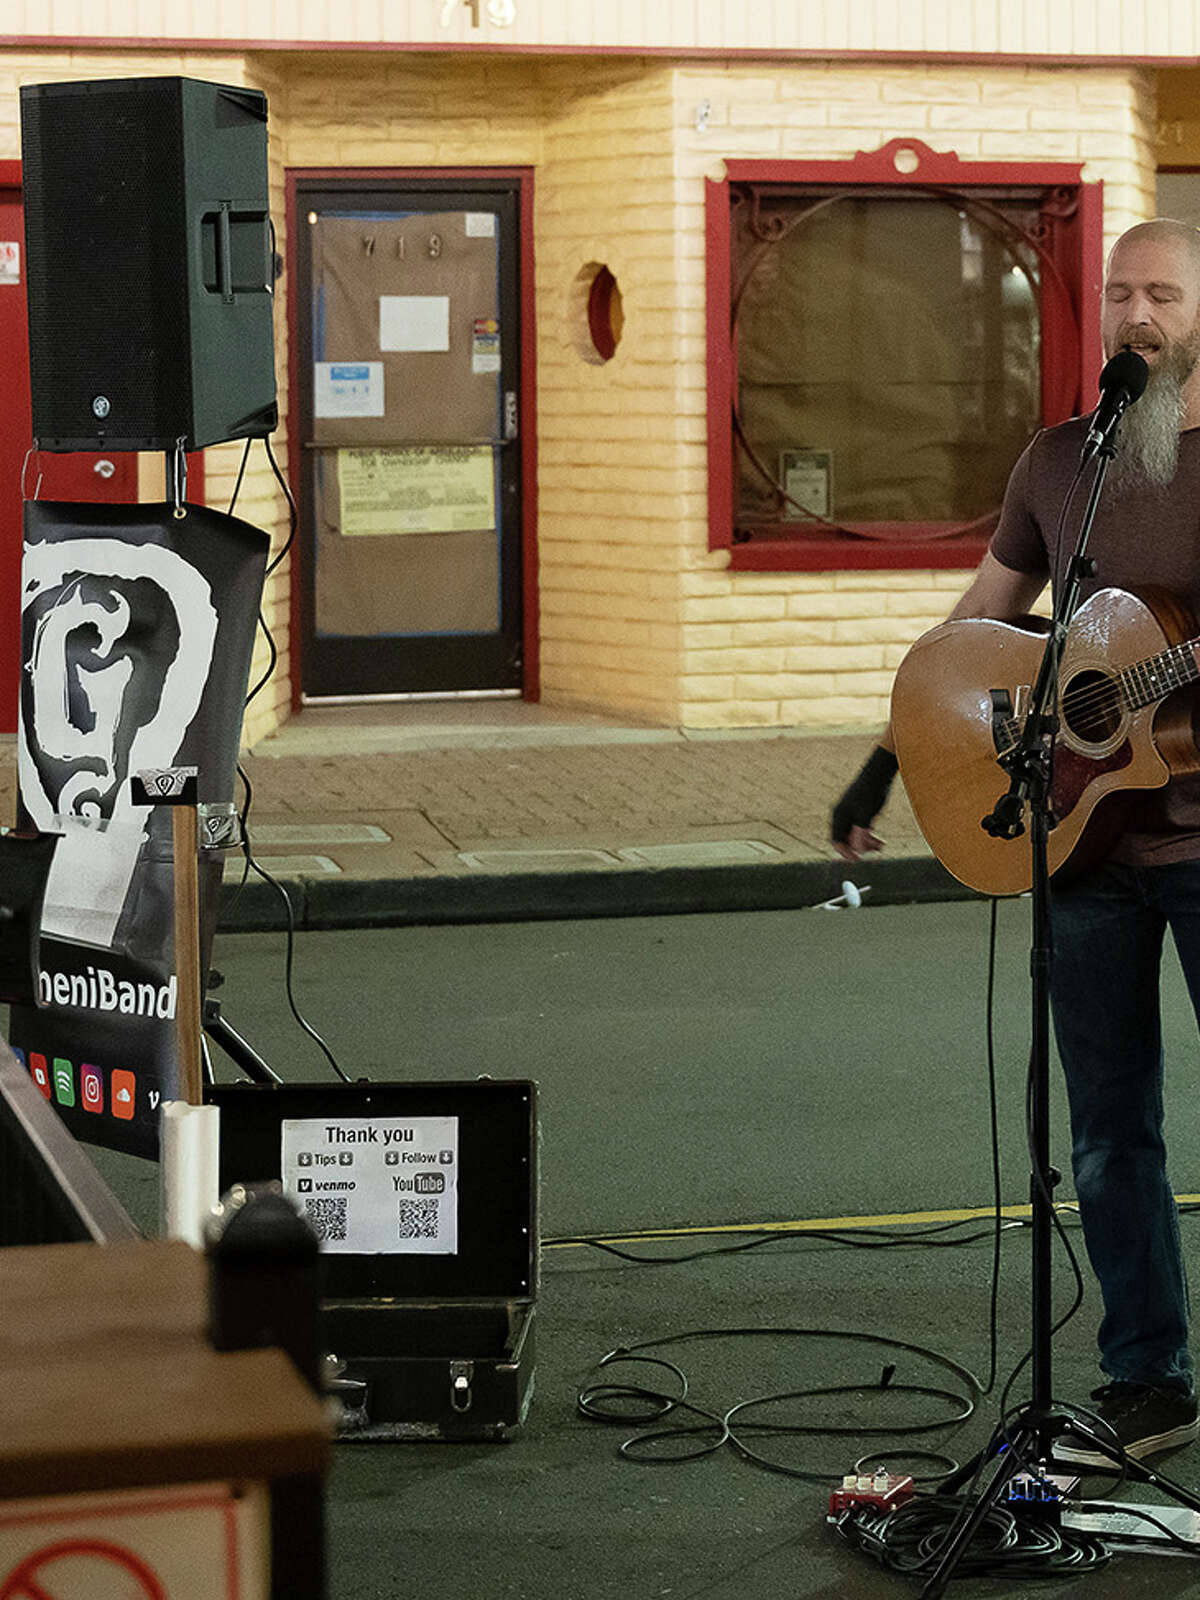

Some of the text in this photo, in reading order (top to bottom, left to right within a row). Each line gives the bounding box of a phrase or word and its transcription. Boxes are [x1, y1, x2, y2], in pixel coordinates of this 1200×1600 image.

[1155, 120, 1184, 146] 21
[363, 234, 442, 258] 719
[326, 1127, 414, 1146] Thank you
[315, 1154, 336, 1167] Tips
[402, 1152, 437, 1164] Follow
[315, 1180, 356, 1191] venmo
[393, 1174, 444, 1194] YouTube
